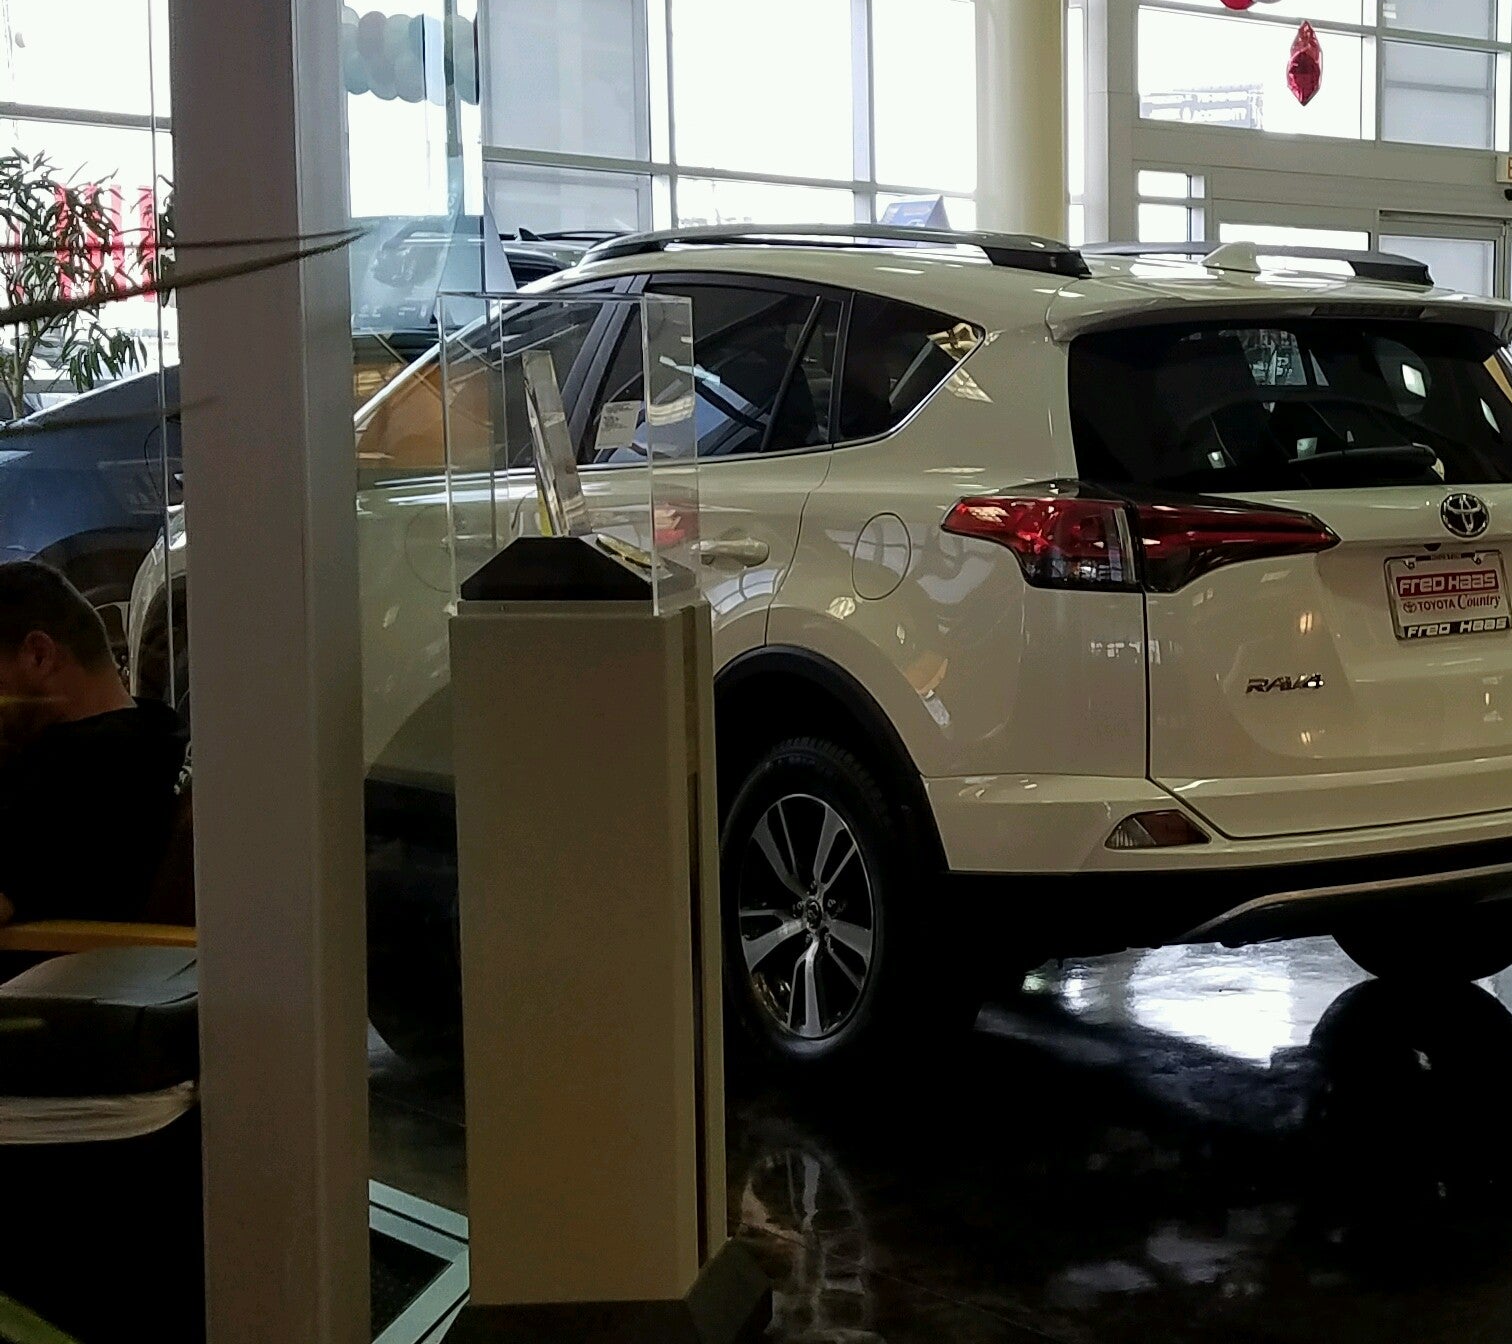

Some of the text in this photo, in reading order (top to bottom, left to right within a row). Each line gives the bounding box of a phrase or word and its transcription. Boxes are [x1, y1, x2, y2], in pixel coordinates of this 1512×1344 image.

[1418, 593, 1501, 612] TOYOTA Country
[1245, 672, 1325, 695] RAV4
